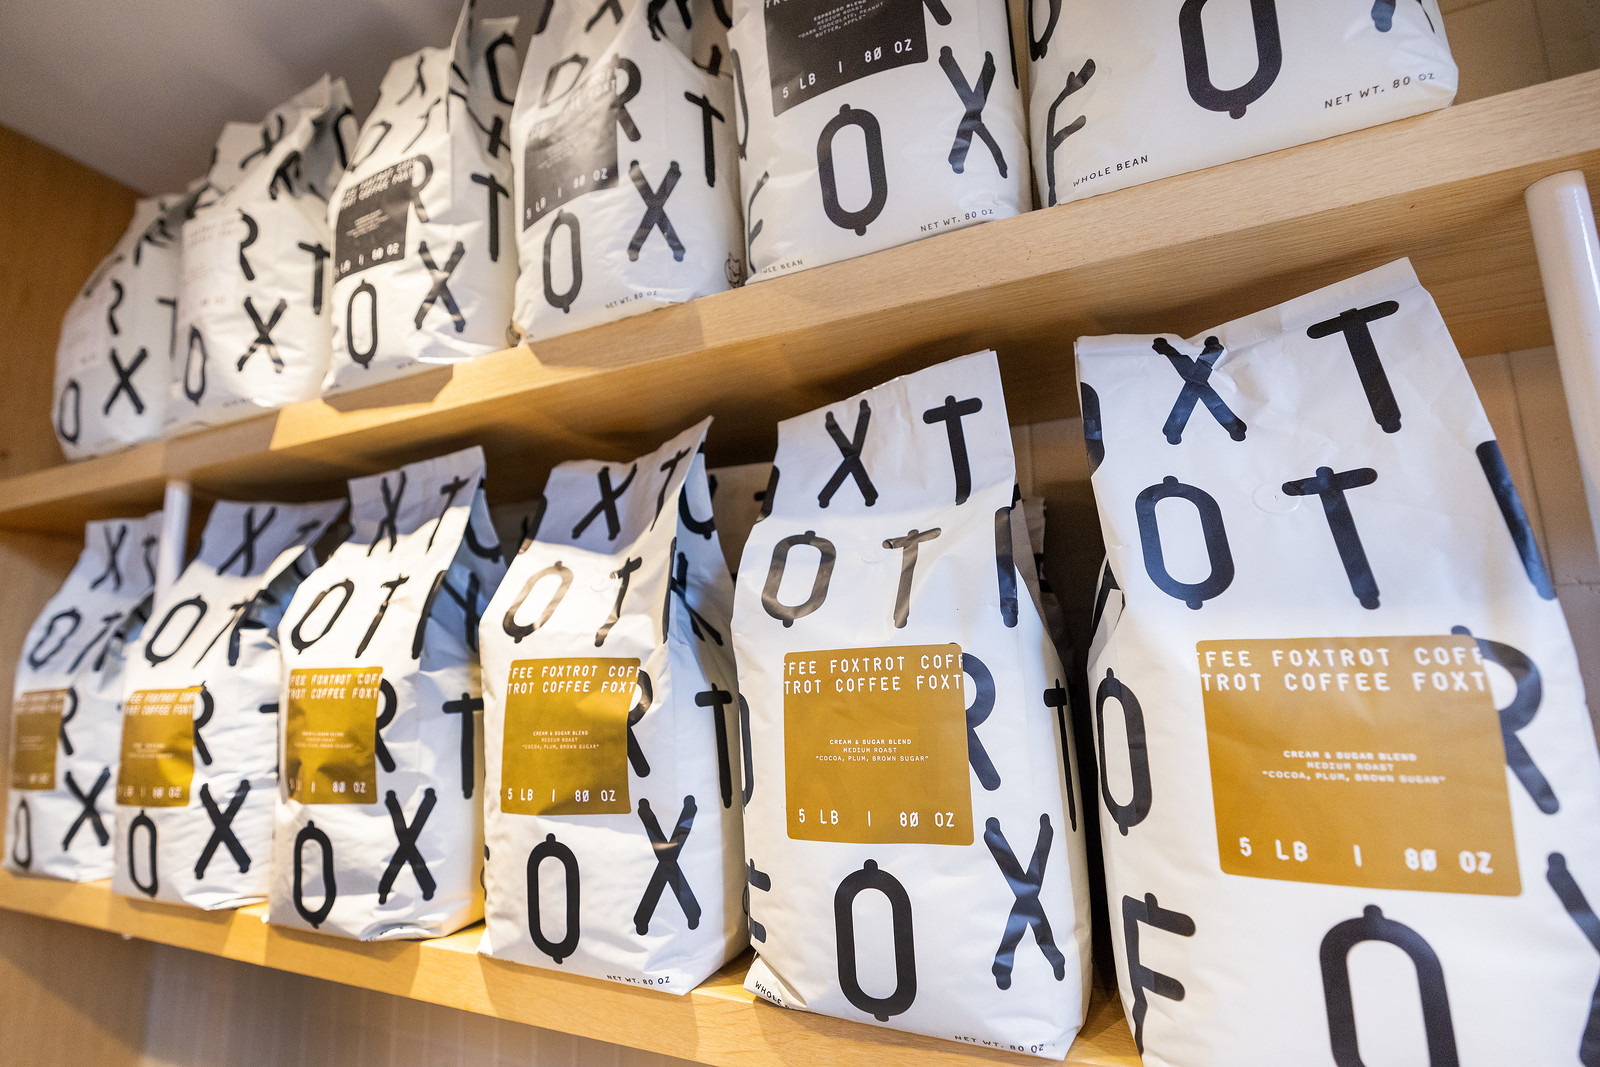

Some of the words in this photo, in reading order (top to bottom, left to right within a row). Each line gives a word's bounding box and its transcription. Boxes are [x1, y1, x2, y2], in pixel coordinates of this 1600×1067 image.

[842, 5, 863, 16] ROAST
[858, 2, 884, 14] PEANUT
[782, 86, 789, 99] 5
[799, 72, 816, 90] LB
[894, 38, 913, 54] OZ
[1324, 93, 1352, 109] NET
[1360, 85, 1385, 98] WT.
[1393, 76, 1411, 89] 80
[1418, 72, 1435, 81] OZ
[684, 91, 726, 188] T
[816, 104, 888, 236] O
[938, 45, 1009, 178] X
[1073, 166, 1111, 187] WHOLE
[1116, 155, 1148, 171] BEAN
[470, 172, 511, 263] T
[542, 208, 584, 313] O
[627, 160, 687, 262] X
[920, 221, 939, 232] NET
[943, 217, 960, 226] WT.
[964, 211, 977, 220] 80
[297, 241, 331, 315] T
[345, 279, 379, 369] O
[413, 241, 466, 333] X
[103, 347, 149, 416] X
[183, 324, 208, 405] O
[238, 296, 288, 373] X
[1152, 336, 1248, 446] X
[1306, 300, 1402, 434] T
[818, 399, 878, 508] X
[922, 396, 983, 506] T
[368, 472, 407, 557] X
[425, 475, 470, 555] T
[571, 464, 638, 541] X
[651, 447, 691, 532] T
[90, 525, 127, 591] X
[217, 507, 277, 578] X
[1134, 475, 1236, 611] O
[1281, 466, 1381, 610] T
[502, 560, 574, 645] O
[594, 555, 642, 648] T
[760, 529, 837, 629] O
[881, 527, 942, 629] T
[145, 594, 208, 668] O
[290, 578, 355, 656] O
[355, 573, 410, 659] T
[310, 687, 346, 699] COFFEE
[352, 687, 379, 699] FOXT
[507, 682, 534, 695] TROT
[542, 680, 591, 693] COFFEE
[601, 681, 637, 693] FOXT
[541, 665, 598, 678] FOXTROT
[784, 679, 822, 694] TROT
[835, 675, 901, 693] COFFEE
[916, 673, 961, 691] FOXT
[830, 655, 905, 674] FOXTROT
[1201, 672, 1262, 692] TROT
[1284, 671, 1390, 692] COFFEE
[1412, 670, 1485, 692] FOXT
[1271, 647, 1390, 668] FOXTROT
[442, 692, 486, 800] T
[694, 683, 732, 808] T
[1096, 667, 1153, 837] O
[1283, 749, 1320, 760] CREAM
[1336, 751, 1374, 761] SUGAR
[1378, 752, 1417, 762] BLEND
[1307, 761, 1352, 771] MEDIUM
[1356, 762, 1394, 772] ROAST
[1354, 774, 1394, 783] BROWN
[63, 766, 111, 851] X
[507, 788, 513, 800] 5
[520, 788, 533, 802] LB
[600, 789, 616, 802] OZ
[798, 808, 805, 823] 5
[819, 809, 839, 826] LB
[934, 811, 954, 828] OZ
[128, 810, 158, 899] O
[194, 780, 251, 880] X
[292, 820, 338, 929] O
[378, 788, 437, 905] X
[1239, 837, 1252, 857] 5
[1275, 838, 1308, 862] LB
[1459, 850, 1493, 874] OZ
[527, 833, 581, 964] O
[633, 795, 702, 936] X
[833, 858, 917, 1023] O
[983, 813, 1066, 991] X
[657, 976, 670, 984] OZ
[755, 980, 782, 1004] WHOLE
[1122, 892, 1196, 1057] F
[1030, 1043, 1044, 1053] OZ
